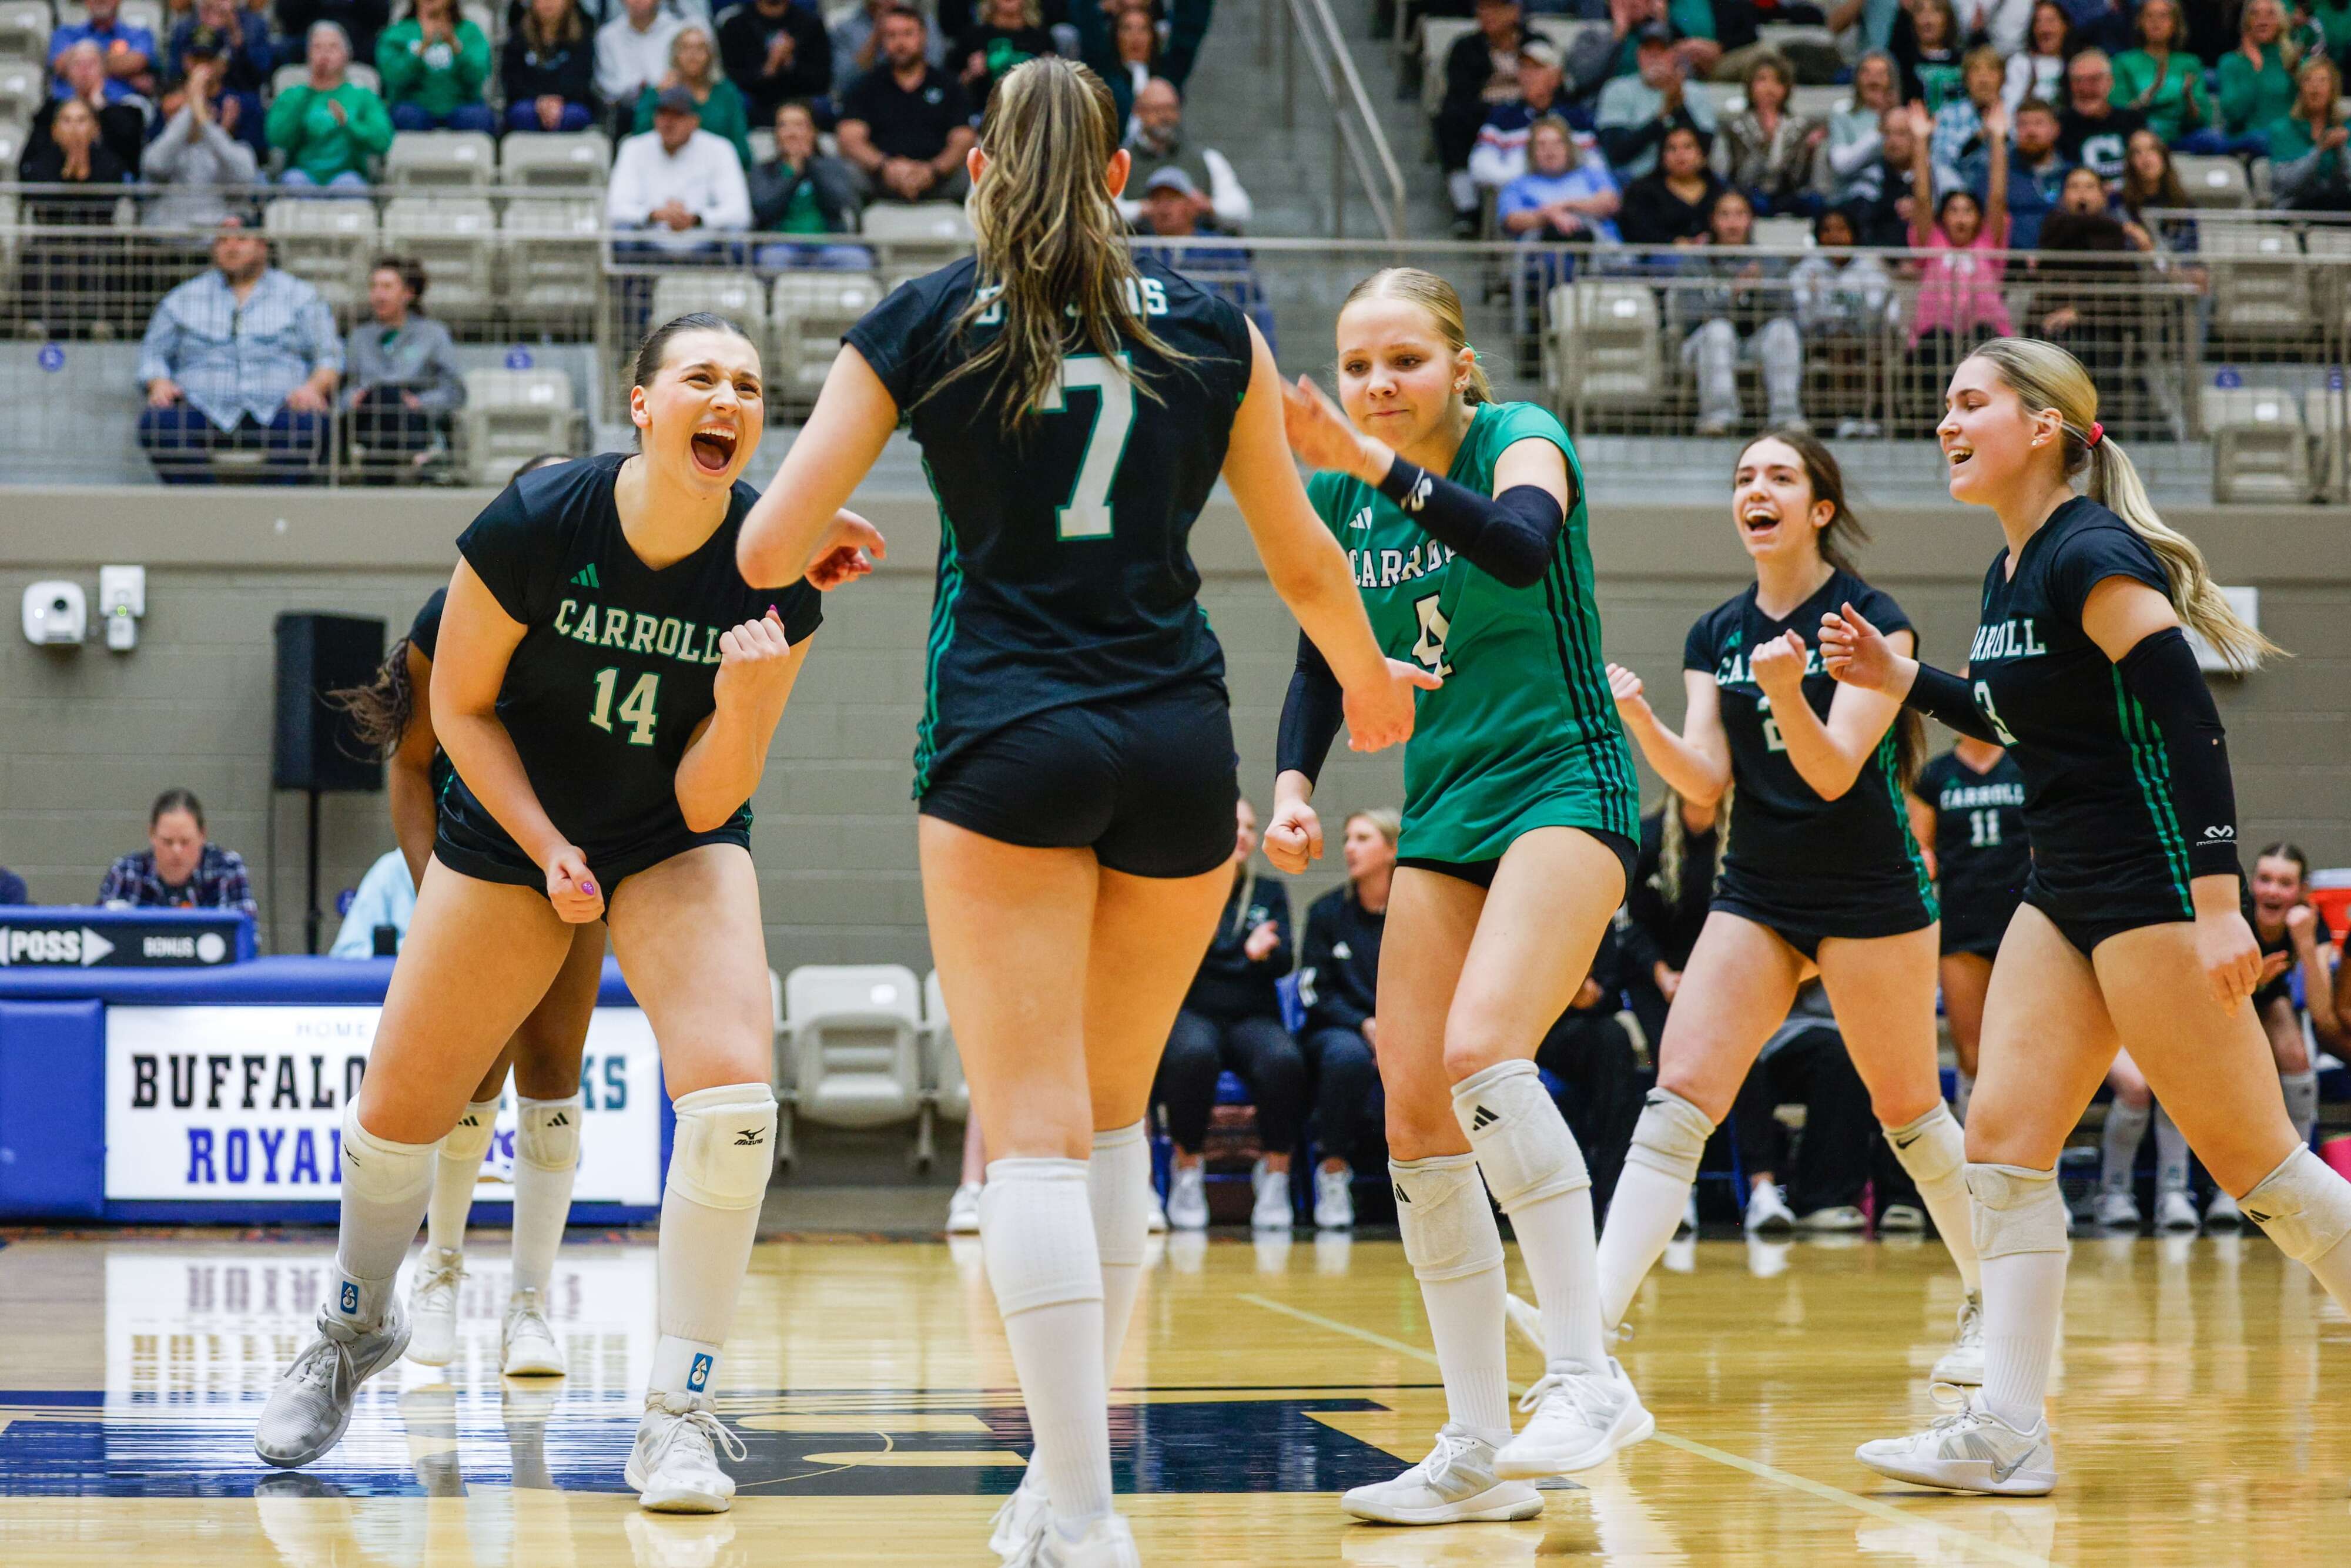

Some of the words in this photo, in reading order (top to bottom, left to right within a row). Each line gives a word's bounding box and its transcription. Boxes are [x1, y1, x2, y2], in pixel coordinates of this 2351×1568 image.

[1030, 351, 1137, 542] 7
[1348, 538, 1458, 588] CARRO
[554, 597, 722, 665] CARROLL
[1411, 590, 1456, 678] 4
[588, 666, 661, 746] 14
[1974, 679, 2020, 747] 3
[1970, 809, 2002, 847] 11
[10, 930, 81, 962] POSS
[142, 936, 196, 958] BONUS
[131, 1054, 368, 1110] BUFFALO
